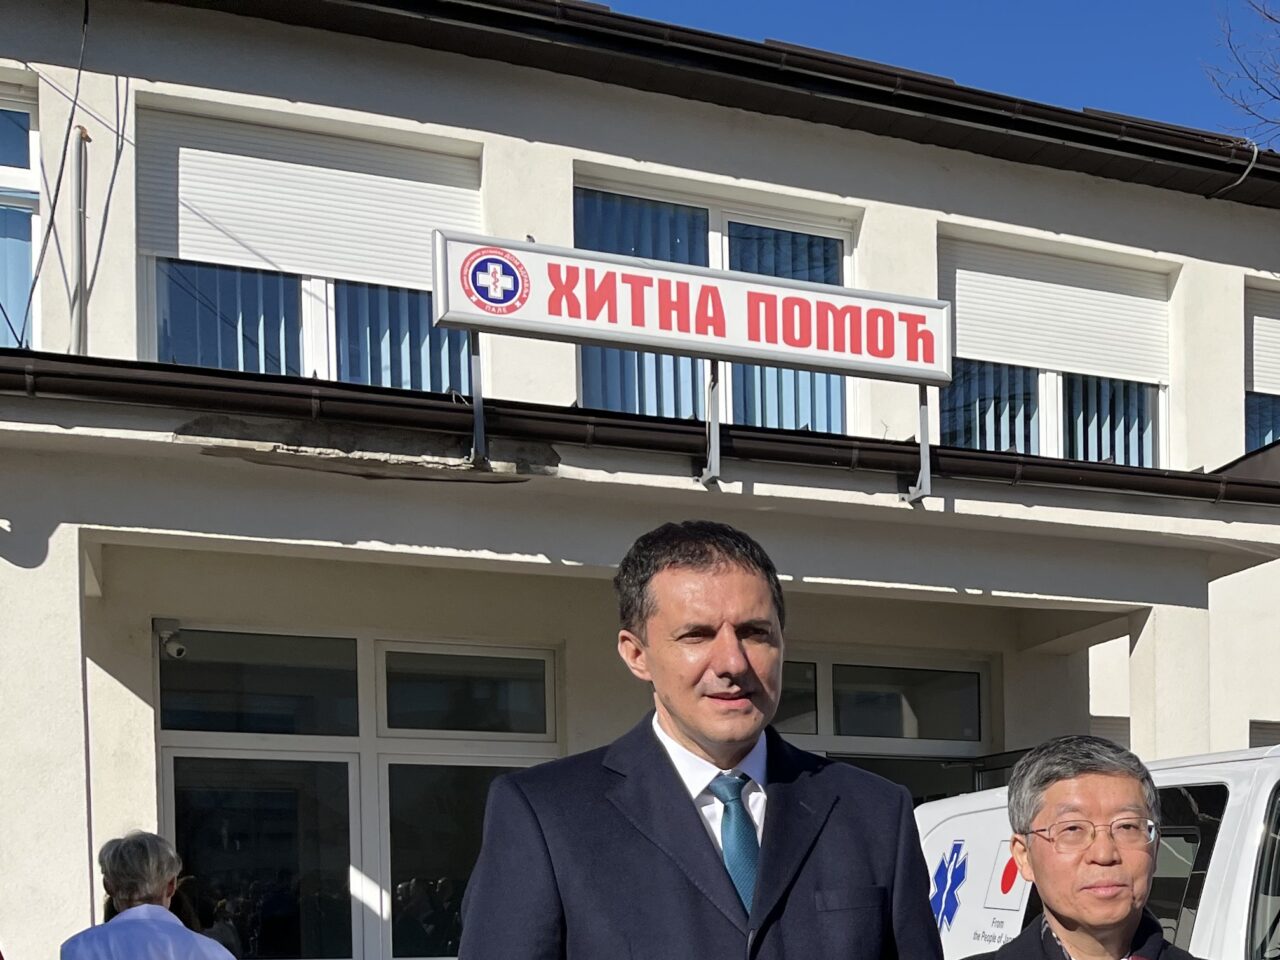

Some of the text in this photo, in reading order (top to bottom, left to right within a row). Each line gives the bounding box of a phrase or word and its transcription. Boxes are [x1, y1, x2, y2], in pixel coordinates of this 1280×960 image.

[485, 305, 508, 314] ПАЛЕ
[547, 262, 727, 338] ХИТНА
[746, 290, 935, 364] ПОМОЋ
[991, 917, 1004, 928] From
[981, 930, 996, 945] People
